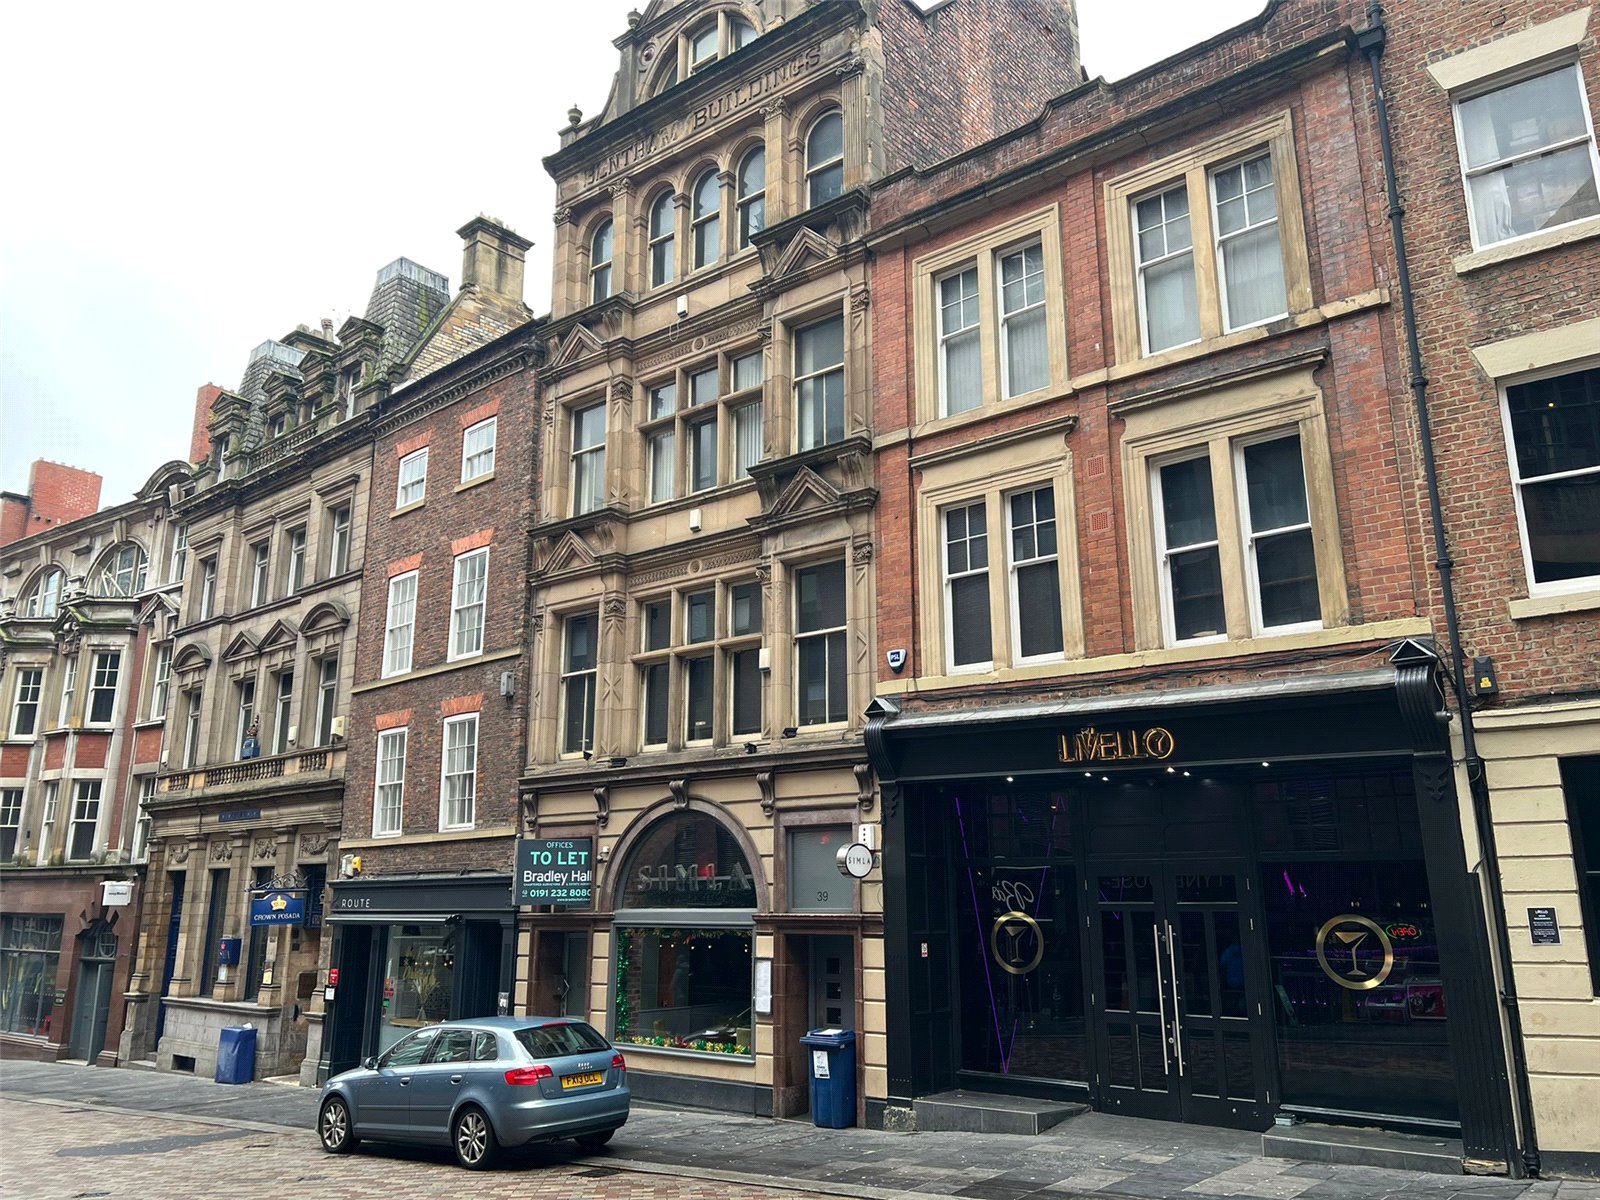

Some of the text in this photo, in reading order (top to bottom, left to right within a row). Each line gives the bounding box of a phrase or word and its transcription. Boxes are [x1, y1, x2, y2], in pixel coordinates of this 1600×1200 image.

[694, 42, 820, 130] BUILDINGS
[1059, 727, 1174, 762] LIVELLO
[530, 851, 588, 865] TO LET
[848, 856, 871, 864] SIMLA
[523, 870, 592, 886] Bradley Hall
[638, 861, 751, 891] SIMLA
[529, 889, 591, 897] 0191 232 8080
[817, 891, 829, 901] 39
[341, 898, 370, 908] ROUTE
[253, 913, 277, 921] CROWN
[567, 1074, 583, 1086] FX13
